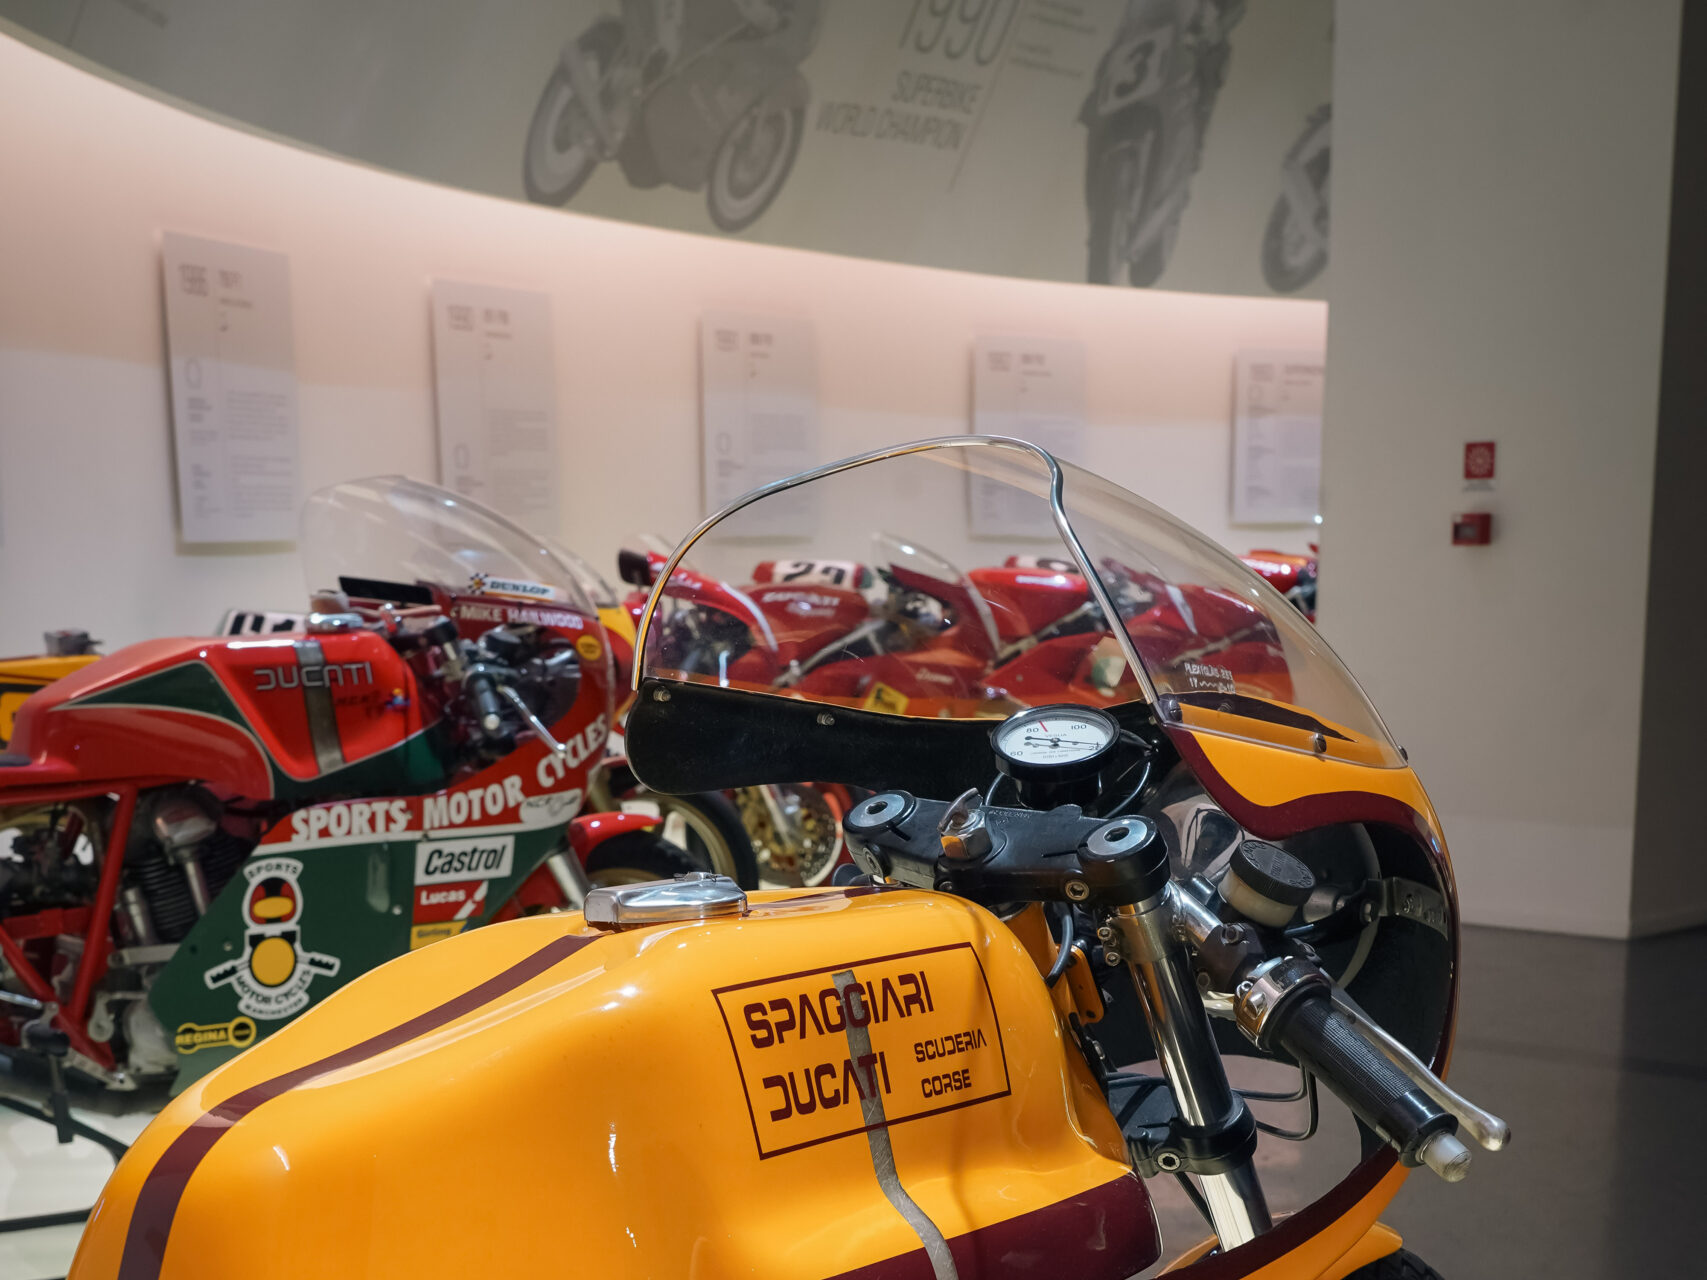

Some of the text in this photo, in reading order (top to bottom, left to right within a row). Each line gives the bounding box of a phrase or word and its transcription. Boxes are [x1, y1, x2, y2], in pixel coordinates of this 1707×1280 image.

[891, 69, 984, 115] SUPERBIKE
[815, 101, 969, 151] WORLD CHAMPION
[490, 580, 550, 596] DUNLOP
[460, 605, 502, 622] MIKE
[253, 660, 374, 691] DUCATI
[291, 713, 609, 843] SPORTS MOTOR CYCLES
[247, 862, 299, 879] SPORTS
[423, 842, 507, 877] Castrol
[419, 888, 467, 906] Lucas
[235, 968, 313, 1006] MOTOR CYCLES
[743, 971, 934, 1050] SPAGGIARI
[175, 1028, 229, 1046] REGINA
[914, 1028, 988, 1063] SCUDERIA
[762, 1051, 892, 1123] DUCATI
[921, 1068, 972, 1098] CORSE
